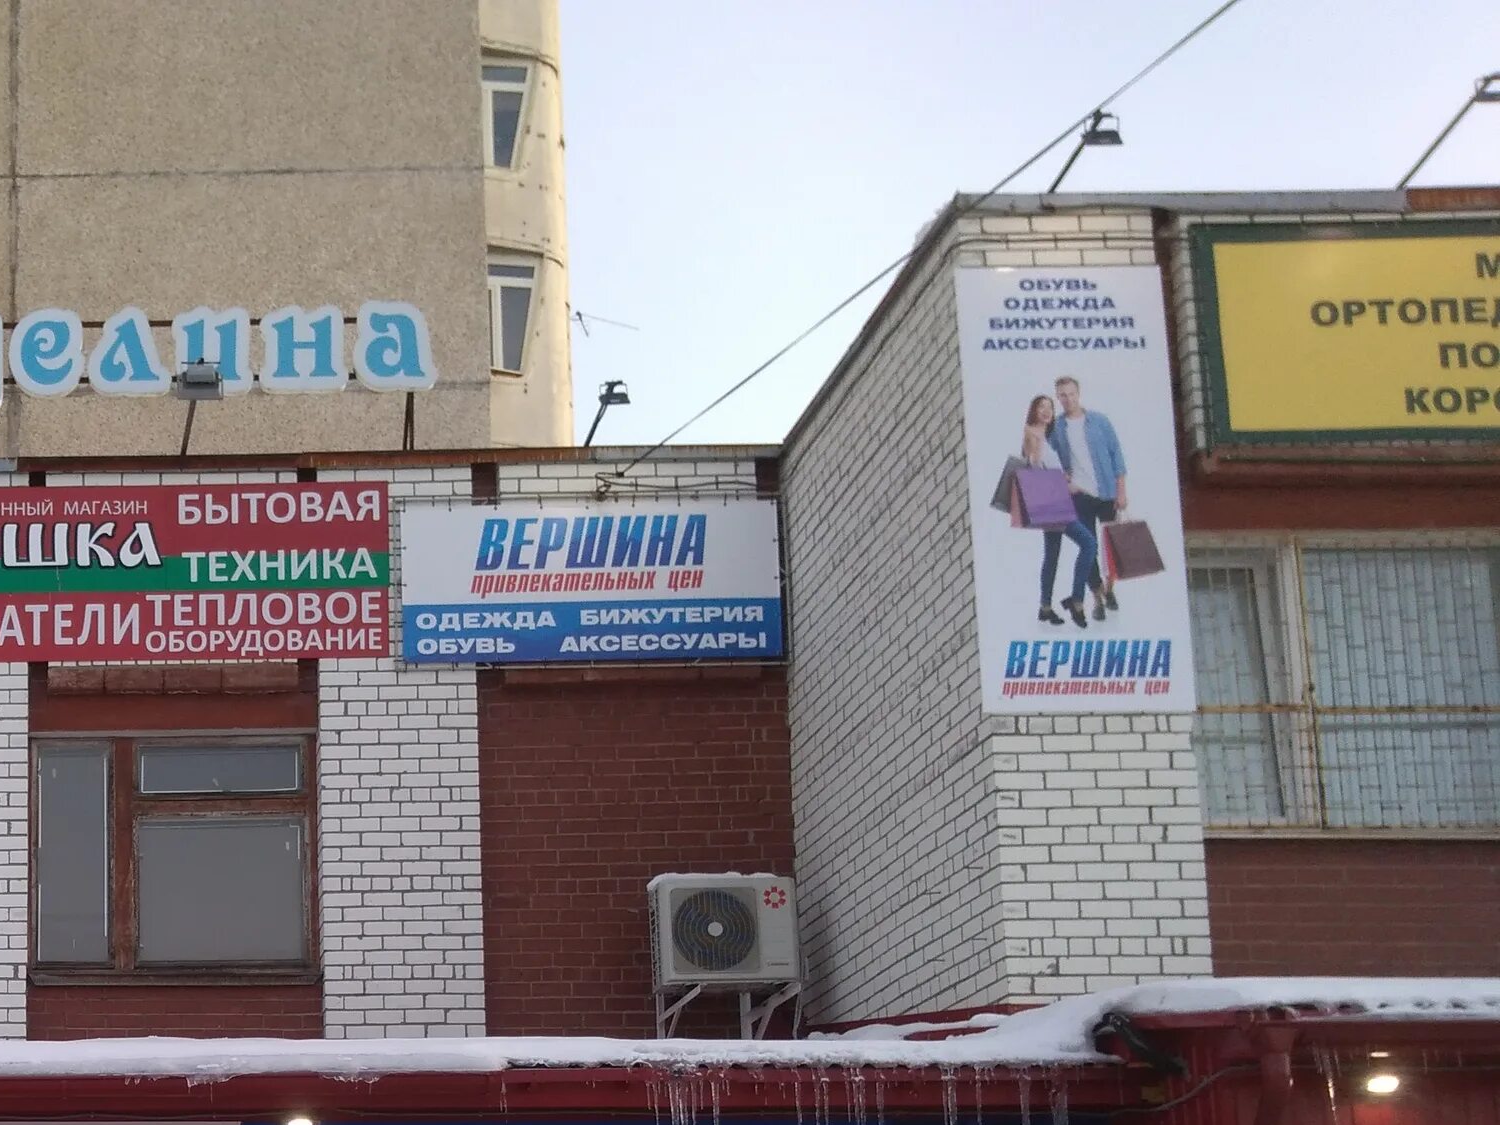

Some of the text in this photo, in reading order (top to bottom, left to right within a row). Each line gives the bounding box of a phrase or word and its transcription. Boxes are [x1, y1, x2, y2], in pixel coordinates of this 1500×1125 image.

[1019, 278, 1097, 291] ОБУВЬ
[1003, 296, 1116, 311] ОДЕЖДА
[988, 316, 1135, 330] БИЖУТЕРИЯ
[982, 336, 1146, 351] АКСЕССУАРЫ
[1404, 386, 1500, 416] КОР
[63, 499, 149, 517] МАГАЗИН
[176, 490, 381, 526] БЫТОВАЯ
[474, 513, 707, 572] ВЕРШИНА
[181, 547, 378, 583] ТЕХНИКА
[470, 569, 704, 599] привлекательных цен
[145, 591, 382, 628] ТЕПЛОВОЕ
[415, 606, 764, 632] ОДЕЖДА БИЖУТЕРИЯ
[143, 627, 383, 656] ОБОРУДОВАНИЕ
[417, 632, 767, 656] ОБУВЬ АКСЕССУАРЫ
[1004, 639, 1172, 679] ВЕРШИНА
[1002, 680, 1171, 699] привлекательных цен
